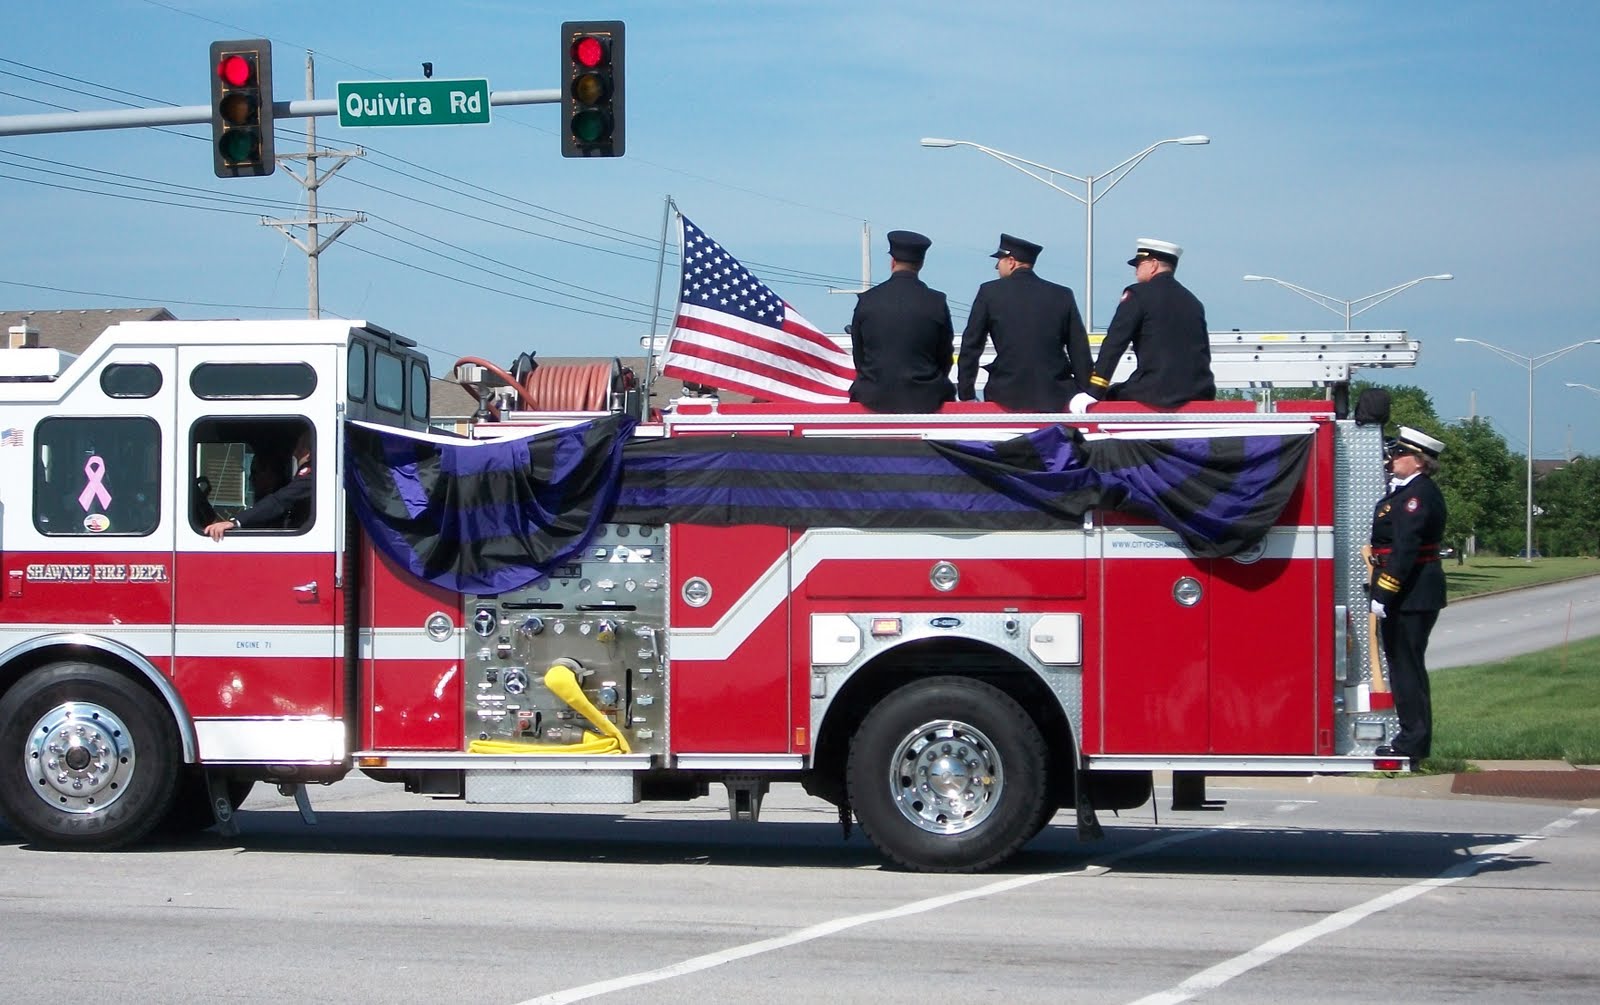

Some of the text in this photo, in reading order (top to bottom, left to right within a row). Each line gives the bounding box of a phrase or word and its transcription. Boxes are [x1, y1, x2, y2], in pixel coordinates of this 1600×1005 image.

[345, 90, 482, 118] Quivira Rd
[26, 563, 92, 582] SHAWNEE
[93, 563, 127, 582] FIRE
[236, 641, 272, 649] ENGINE 71
